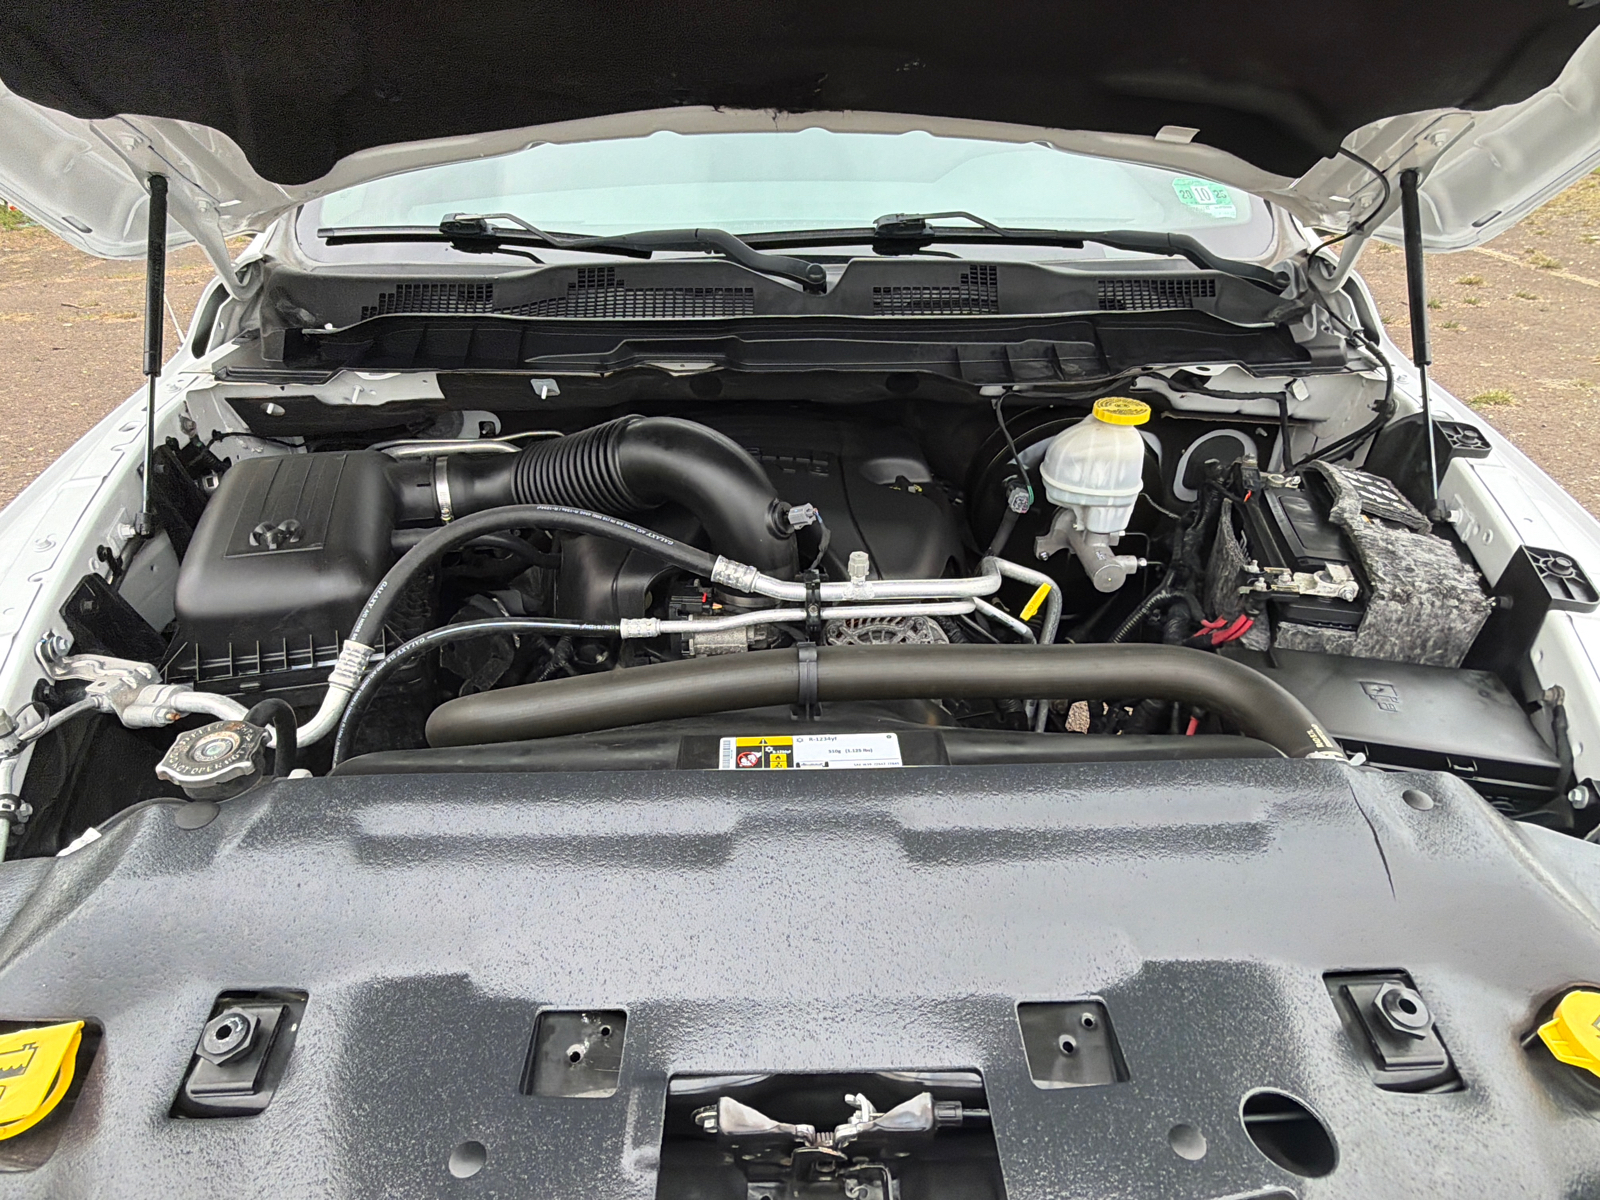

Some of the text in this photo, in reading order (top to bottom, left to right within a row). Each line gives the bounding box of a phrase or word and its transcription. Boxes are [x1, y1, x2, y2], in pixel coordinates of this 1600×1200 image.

[1179, 189, 1193, 199] 20
[1194, 187, 1211, 201] 10
[646, 532, 674, 546] GALAXY
[368, 581, 388, 609] GALAXY
[397, 637, 426, 657] GALAXY
